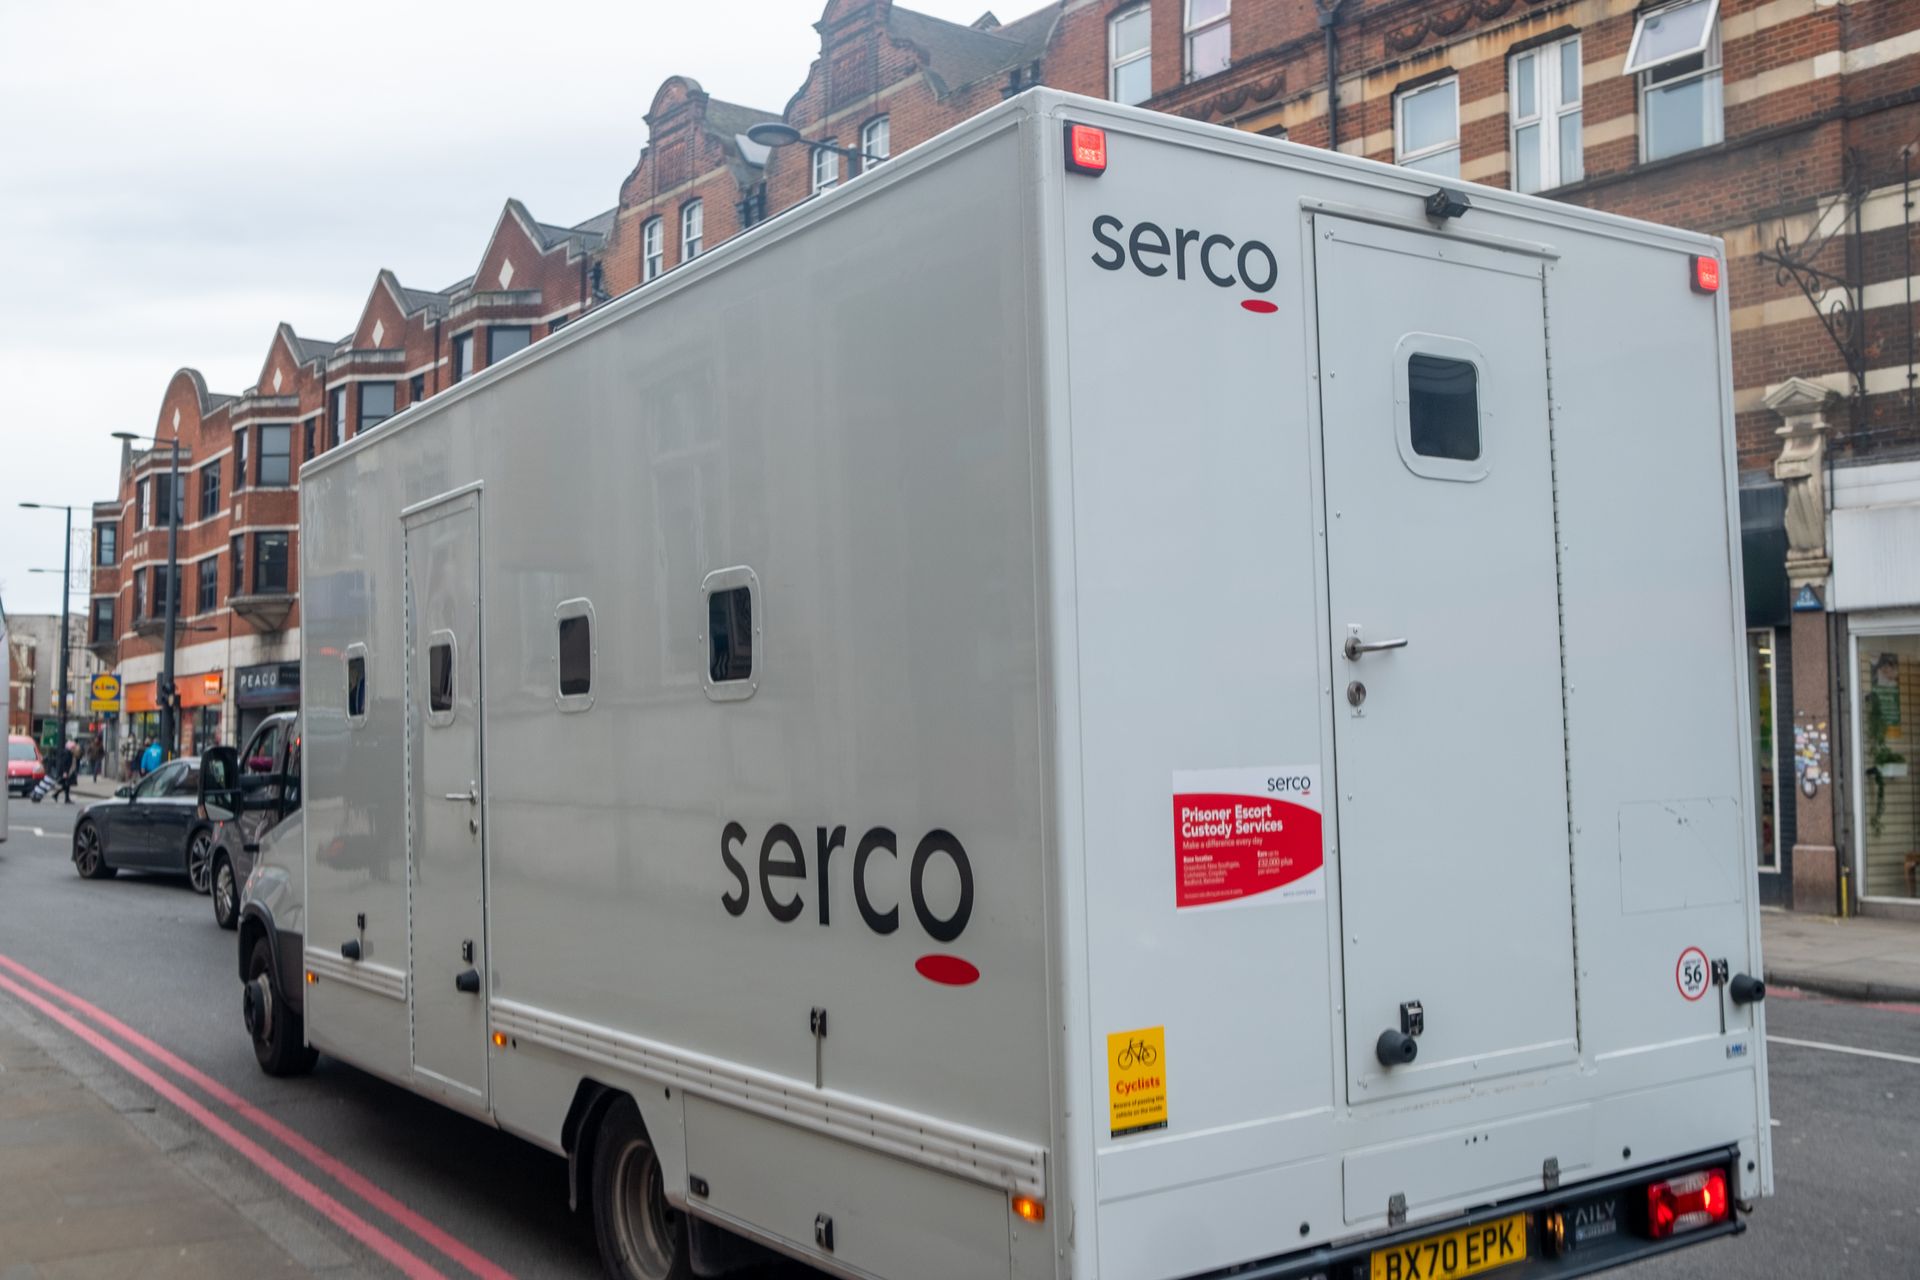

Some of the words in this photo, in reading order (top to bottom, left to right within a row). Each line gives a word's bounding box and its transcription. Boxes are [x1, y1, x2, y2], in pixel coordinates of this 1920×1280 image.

[1091, 214, 1278, 293] serco
[1267, 776, 1311, 792] serco
[1181, 806, 1231, 823] Prisoner
[1235, 803, 1272, 820] Escort
[1182, 820, 1232, 839] Custody
[1235, 818, 1283, 835] Services
[721, 821, 974, 943] serco
[1684, 964, 1702, 986] 56
[1116, 1076, 1160, 1096] Cyclists
[1385, 1238, 1458, 1280] BX70
[1466, 1221, 1514, 1269] EPK
